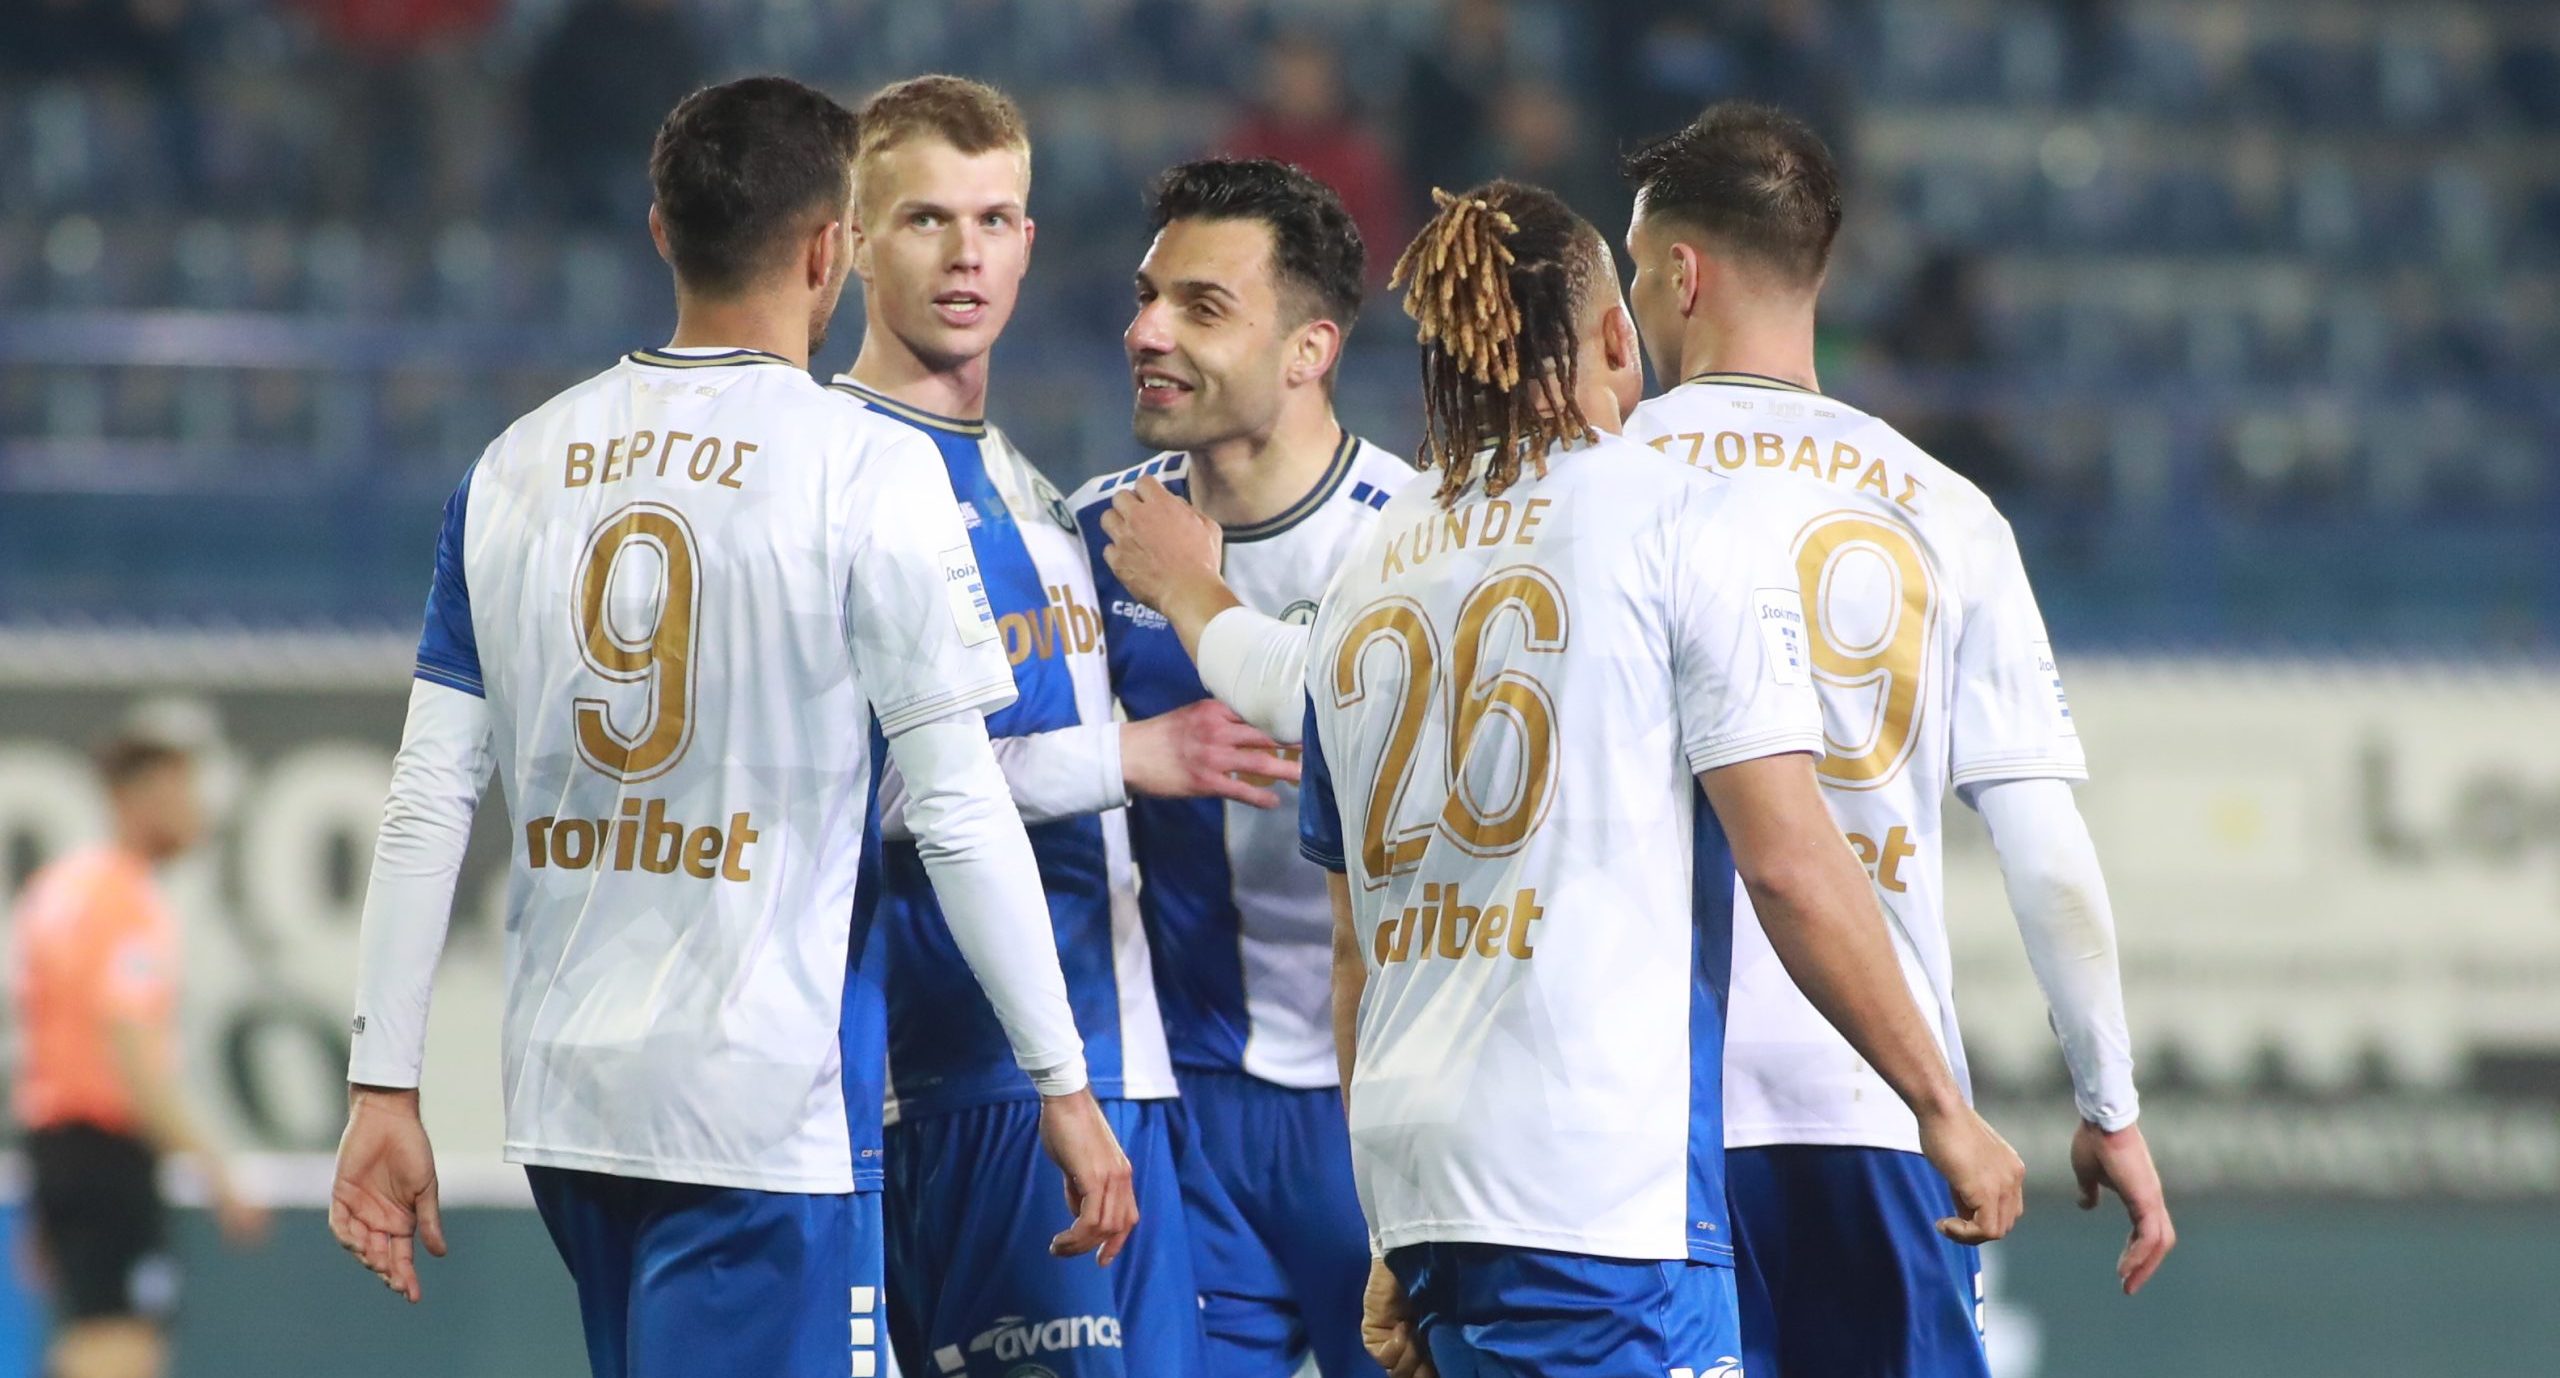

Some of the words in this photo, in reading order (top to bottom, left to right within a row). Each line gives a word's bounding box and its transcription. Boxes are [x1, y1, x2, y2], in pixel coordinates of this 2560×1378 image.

[564, 430, 758, 489] ΒΕΡΓΟΣ
[946, 565, 978, 582] Stoix
[1381, 498, 1551, 583] KUNDE
[570, 501, 702, 785] 9
[997, 583, 1105, 666] ovib
[1789, 508, 1939, 792] 9
[1331, 564, 1570, 892] 26
